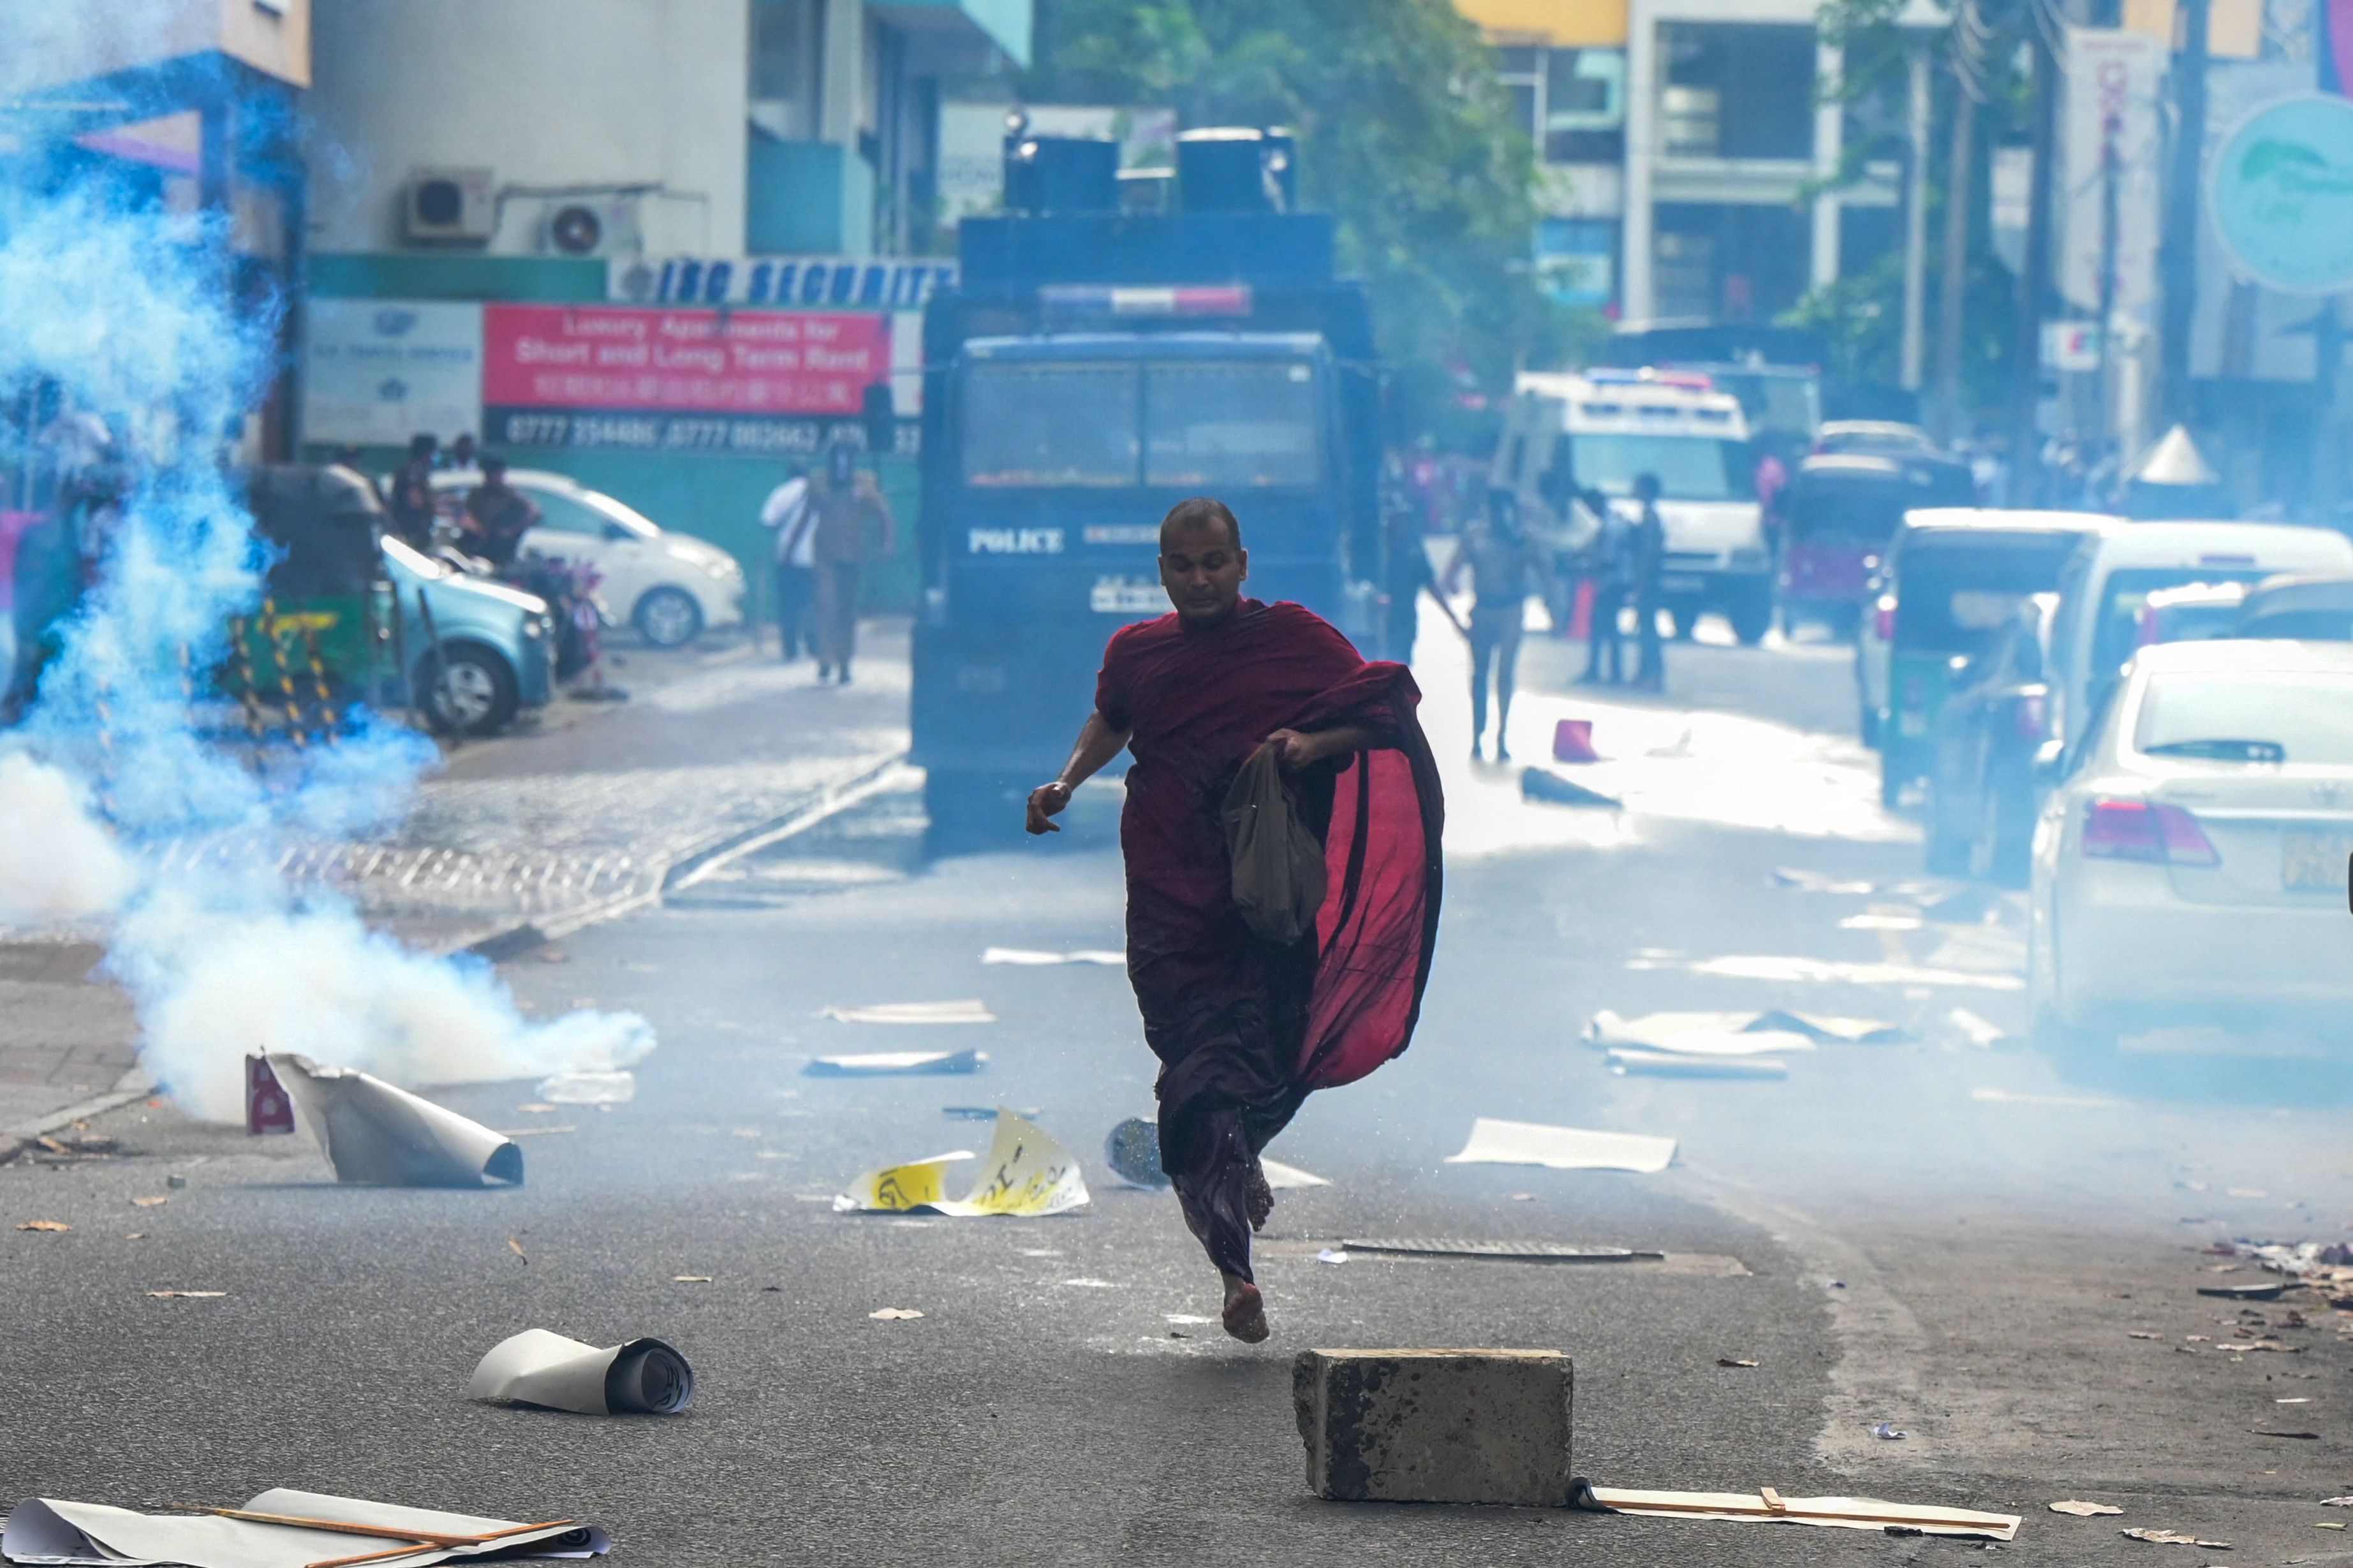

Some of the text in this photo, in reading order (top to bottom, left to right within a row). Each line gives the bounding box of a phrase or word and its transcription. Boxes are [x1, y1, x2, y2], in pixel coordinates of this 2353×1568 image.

[515, 337, 870, 373] Short and Long Term Rent
[508, 416, 566, 443] 0777
[968, 529, 1064, 553] POLICE
